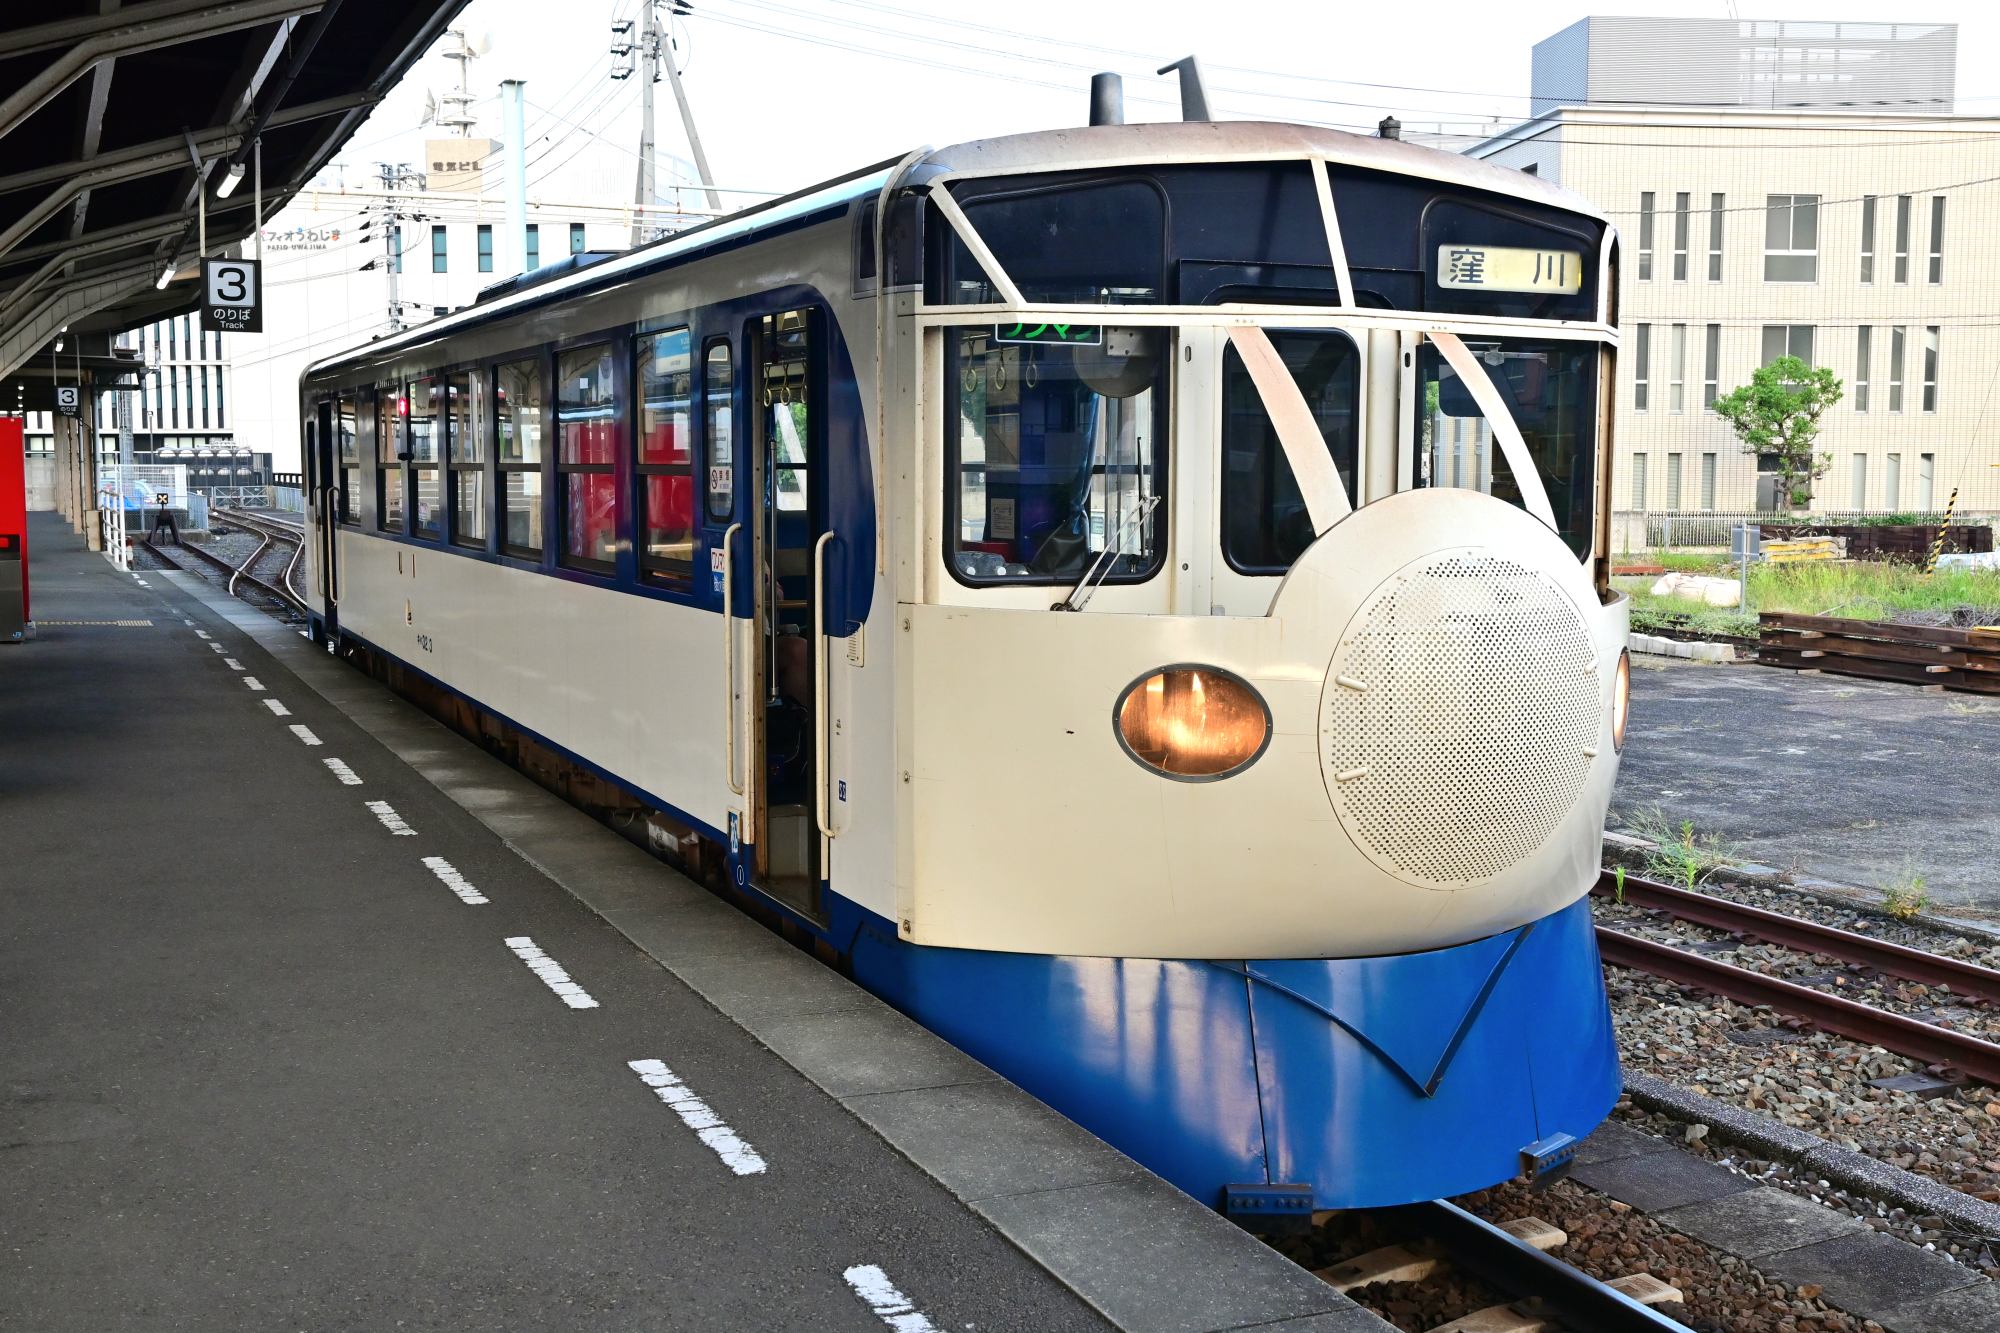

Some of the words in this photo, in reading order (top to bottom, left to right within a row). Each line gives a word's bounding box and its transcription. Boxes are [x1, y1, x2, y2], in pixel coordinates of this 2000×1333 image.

[217, 267, 246, 301] 3
[213, 308, 251, 320] のりば
[220, 321, 244, 329] Track
[62, 389, 74, 404] 3
